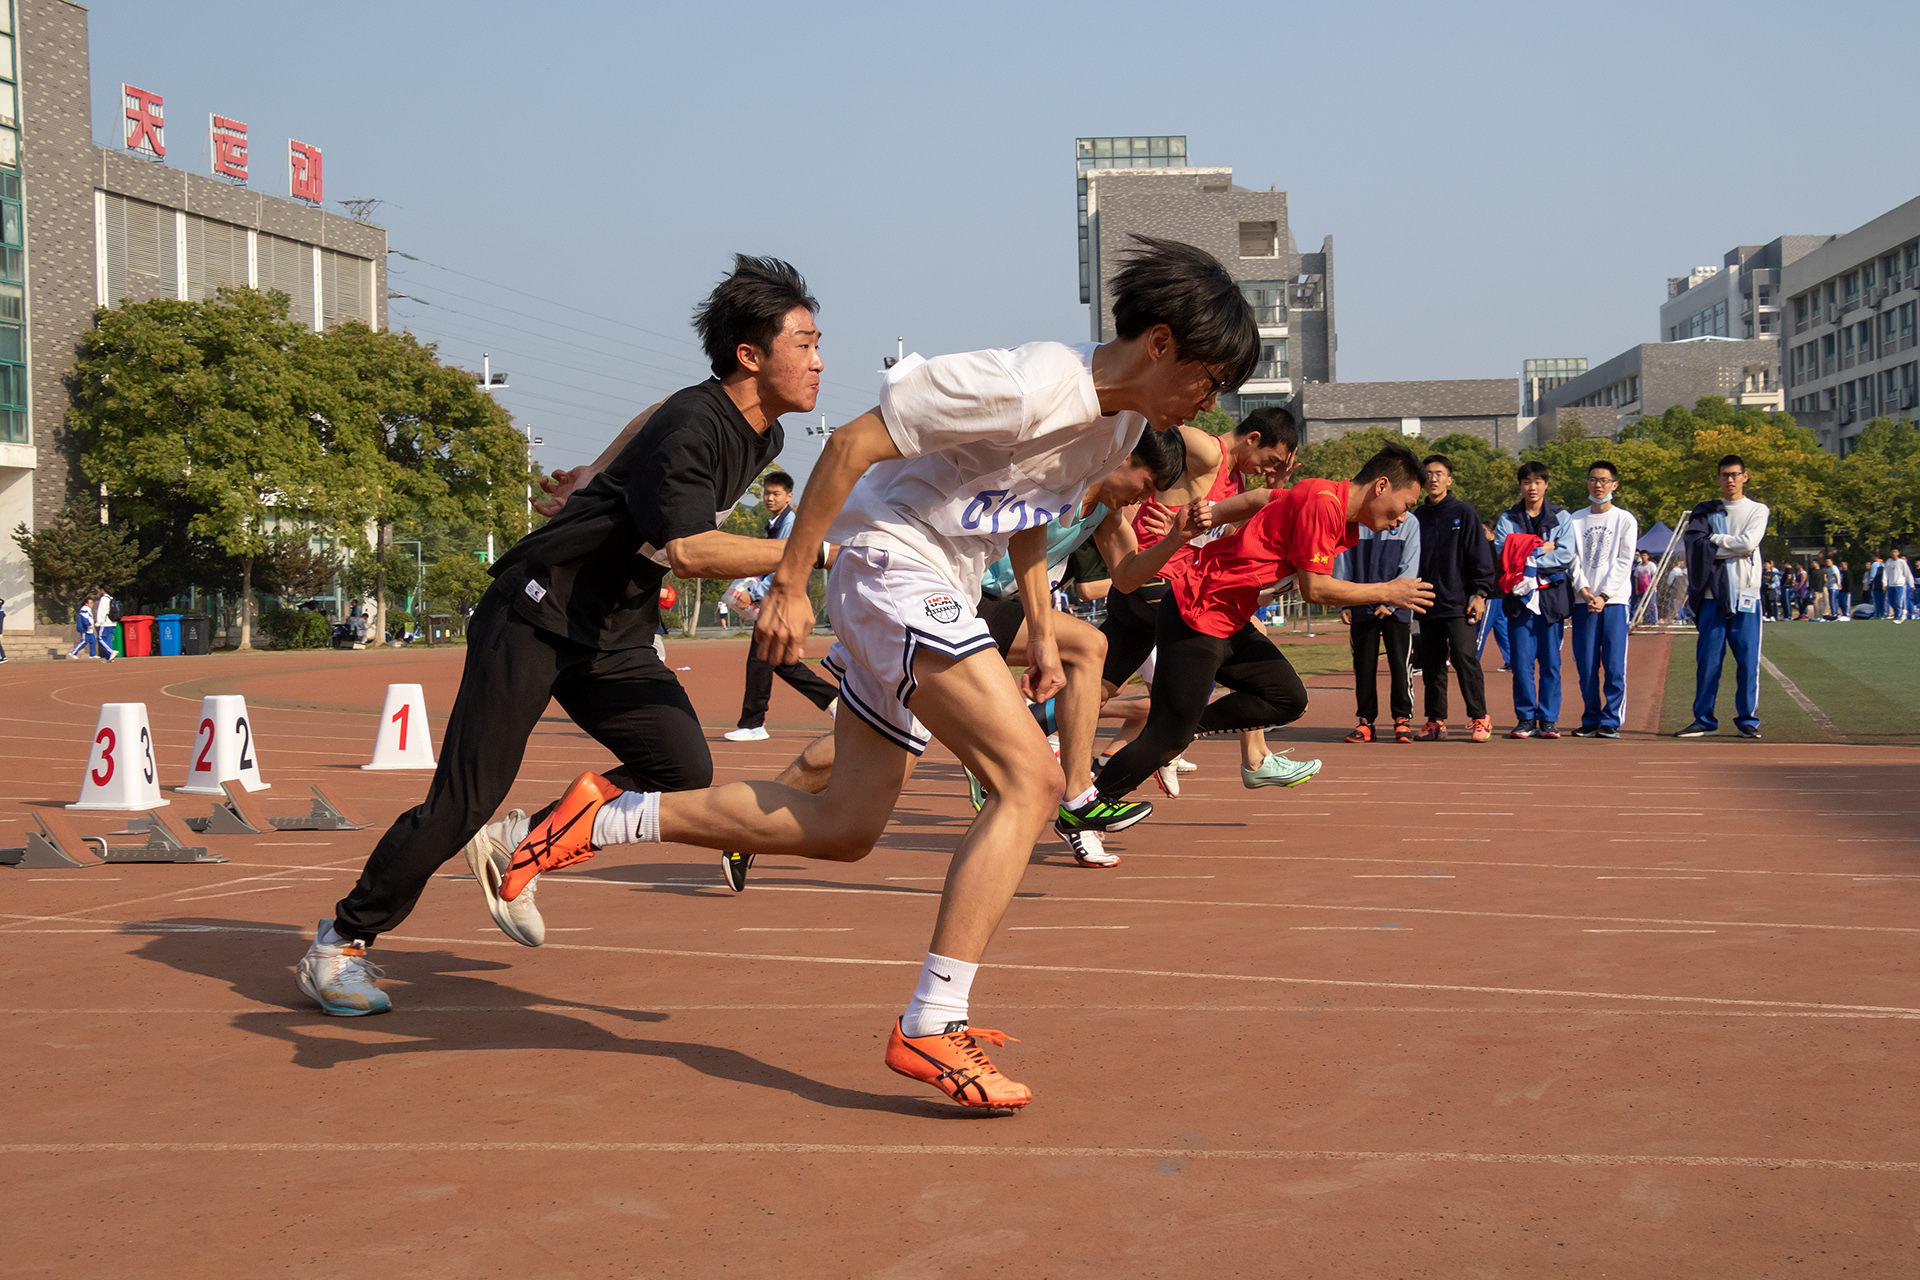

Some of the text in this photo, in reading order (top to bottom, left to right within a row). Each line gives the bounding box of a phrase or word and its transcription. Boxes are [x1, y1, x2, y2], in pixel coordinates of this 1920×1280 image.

[195, 718, 215, 772] 2
[235, 716, 253, 770] 2
[391, 704, 410, 751] 1
[91, 727, 116, 787] 3
[140, 726, 154, 785] 3
